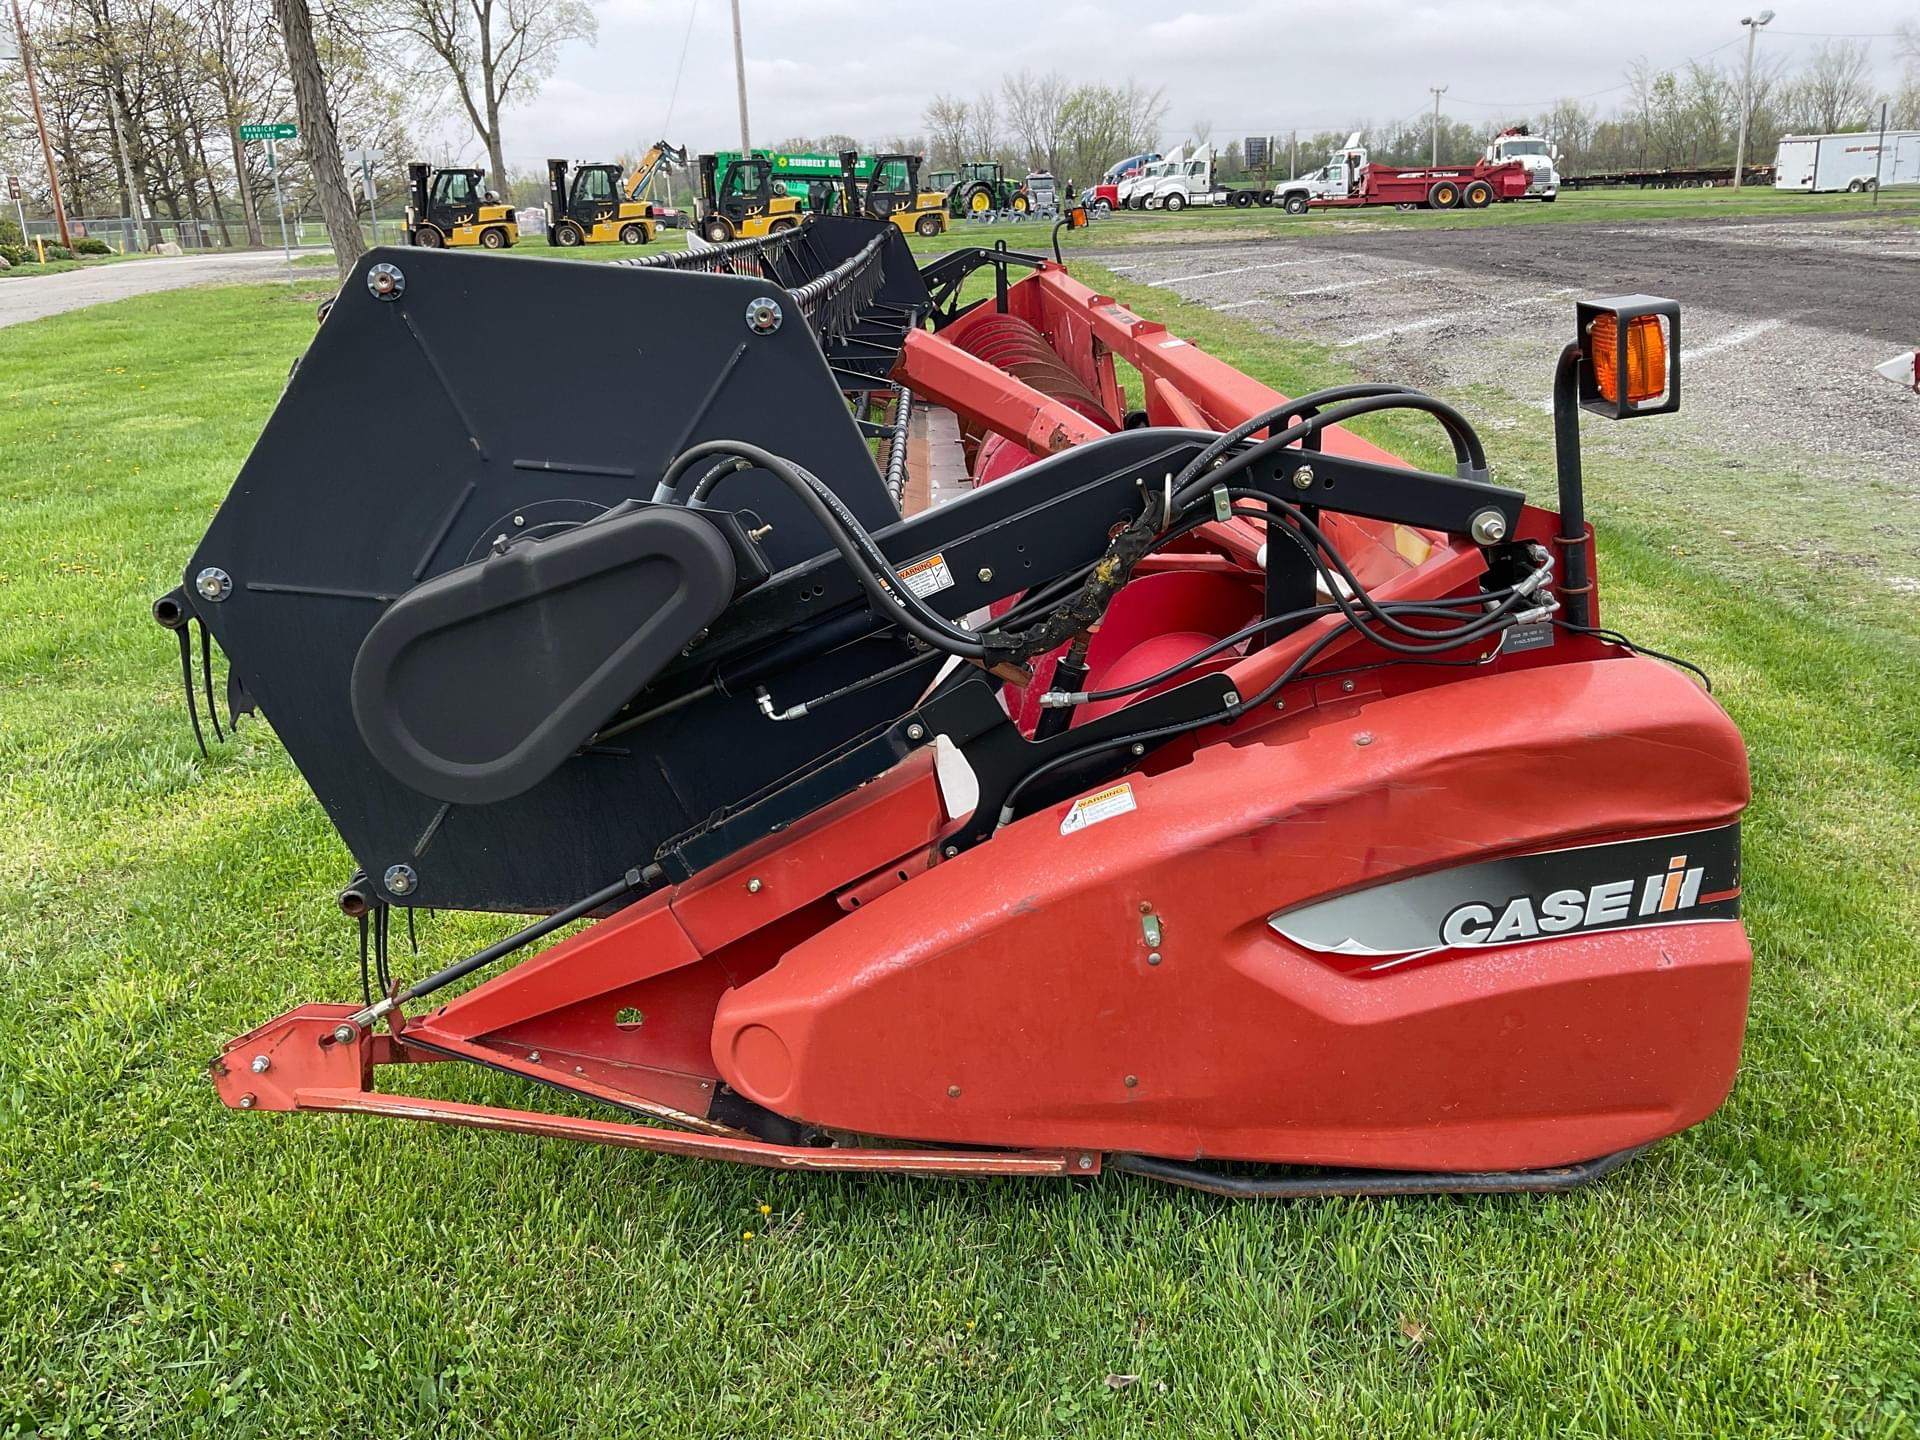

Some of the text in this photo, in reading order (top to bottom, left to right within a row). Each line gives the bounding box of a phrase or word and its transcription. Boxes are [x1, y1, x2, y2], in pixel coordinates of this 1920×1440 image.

[788, 158, 826, 167] SUNBELT
[1078, 788, 1124, 808] WARNING
[1442, 880, 1634, 945] CASE
